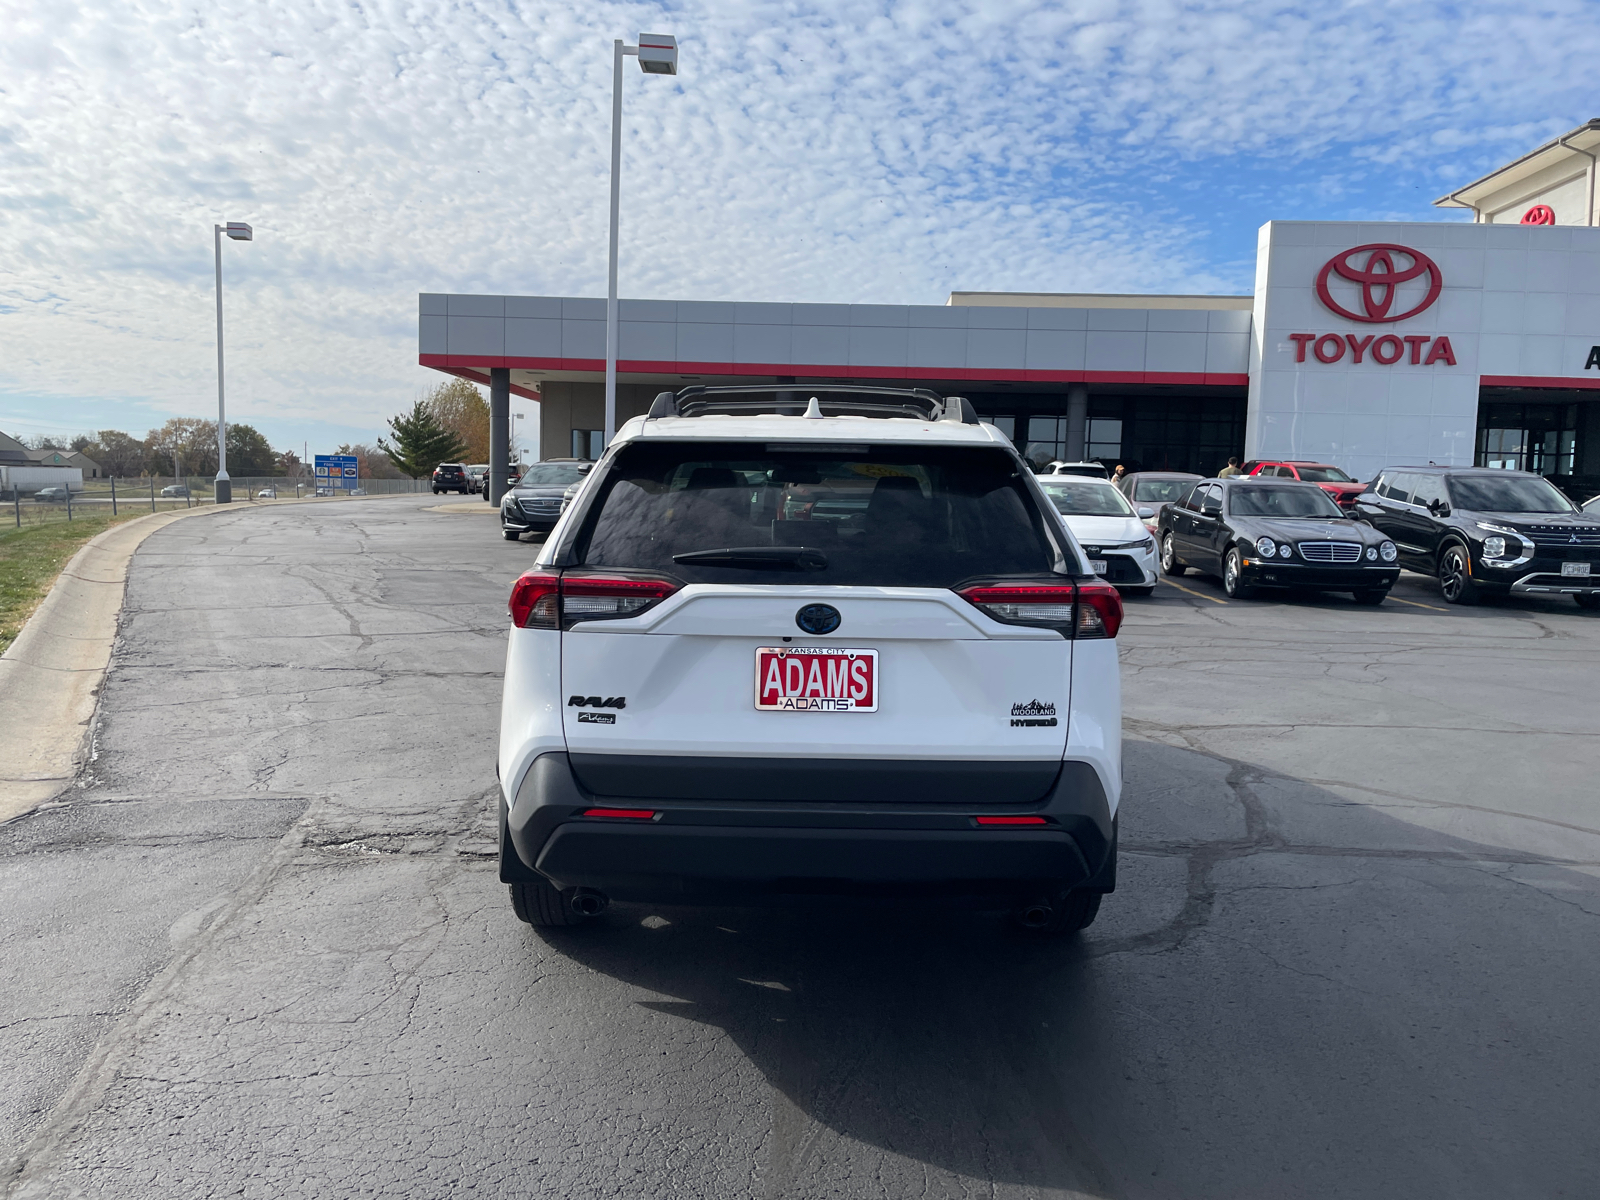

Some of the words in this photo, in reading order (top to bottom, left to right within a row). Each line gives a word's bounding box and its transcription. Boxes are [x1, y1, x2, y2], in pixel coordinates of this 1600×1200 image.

[1290, 333, 1457, 366] TOYOTA
[763, 658, 868, 701] ADAMS
[567, 695, 626, 709] RAV4
[783, 698, 849, 710] ADAMS
[1012, 708, 1055, 716] WOODLAND
